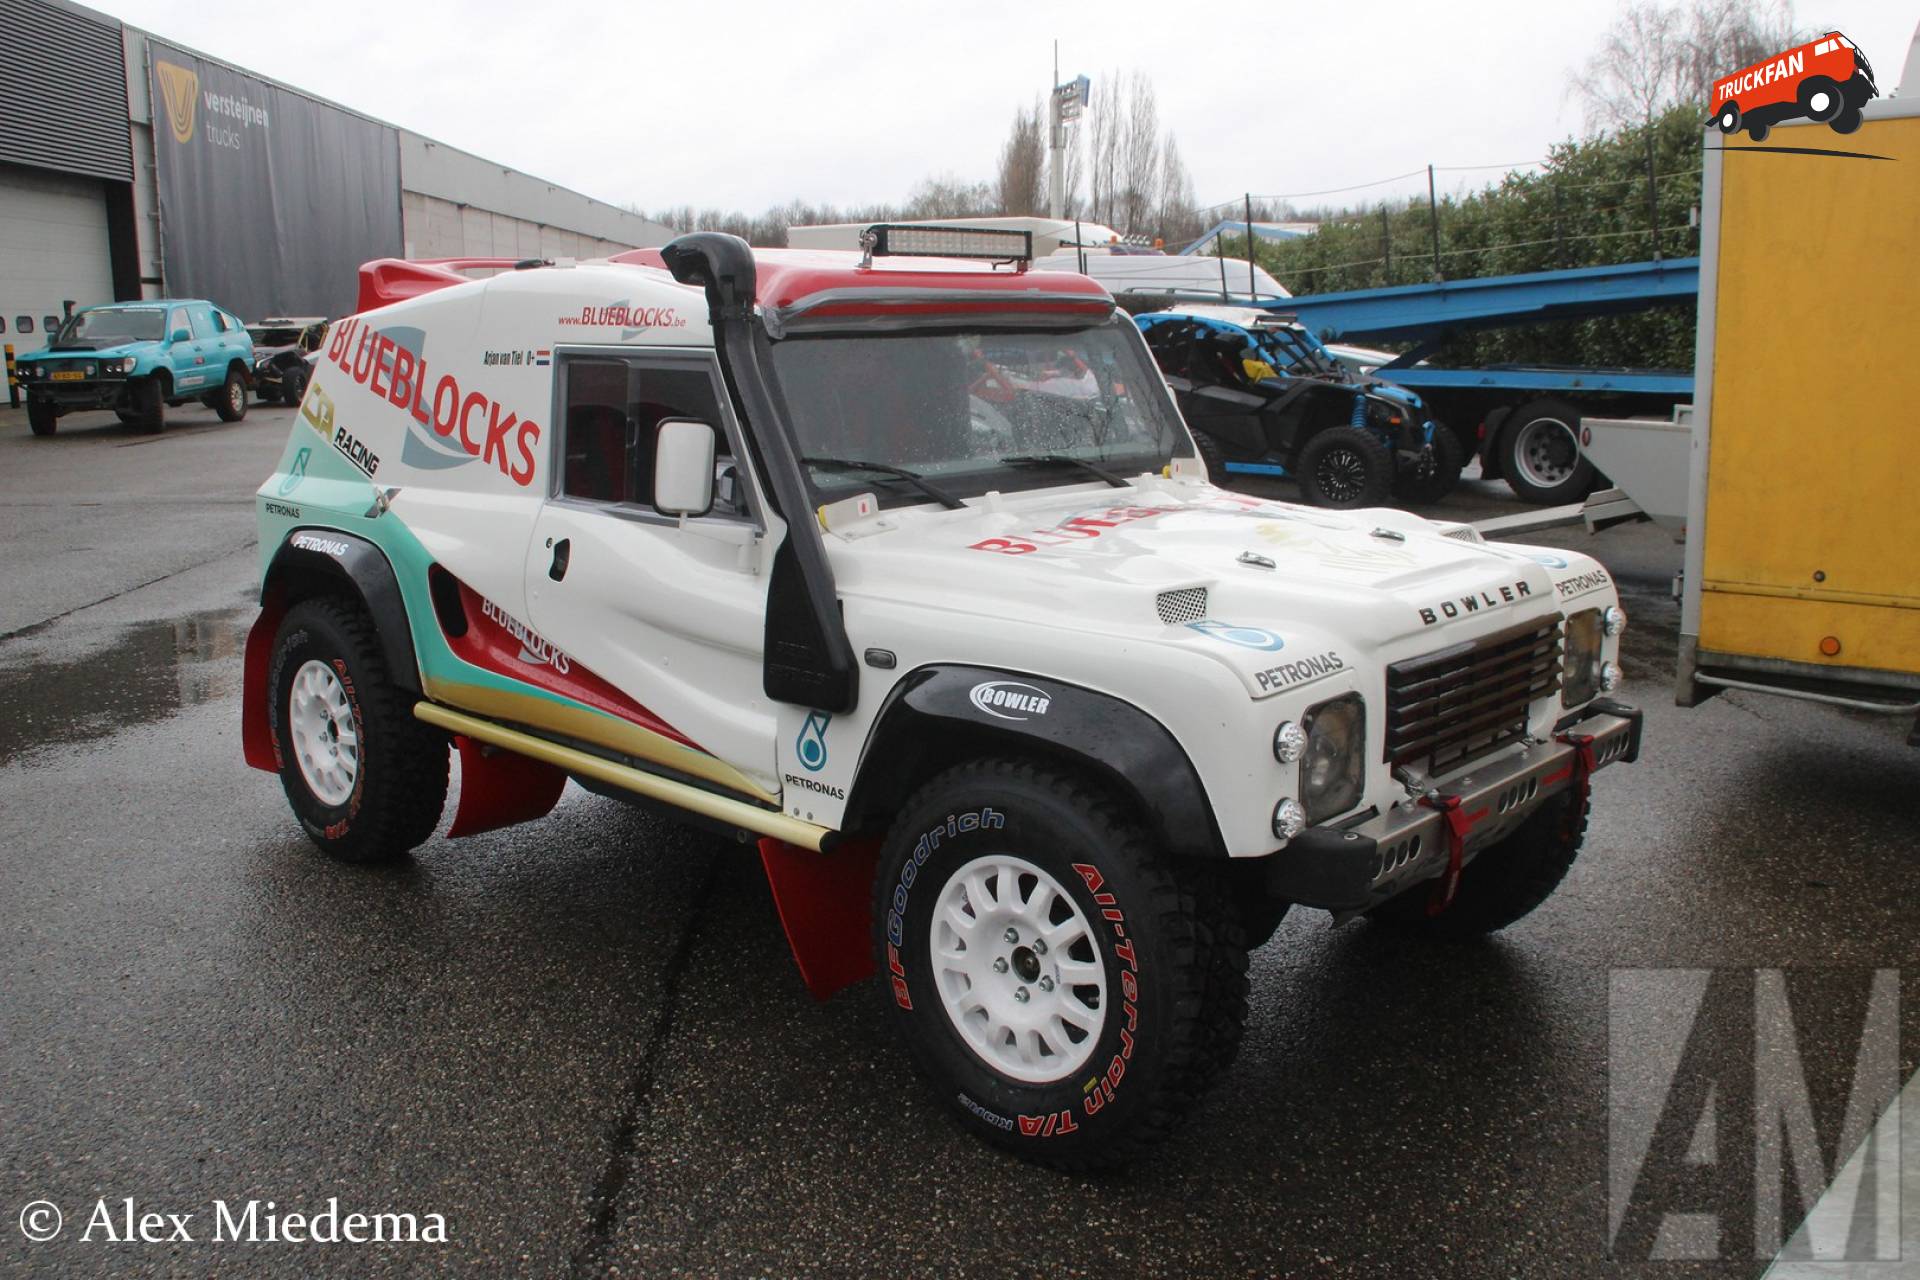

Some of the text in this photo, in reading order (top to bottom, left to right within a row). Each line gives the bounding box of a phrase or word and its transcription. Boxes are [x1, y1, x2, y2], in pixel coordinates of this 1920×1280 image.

[204, 91, 269, 128] versteijnen
[206, 121, 241, 150] trucks
[558, 306, 686, 328] www.BLUEBLOCKS.be
[500, 353, 510, 365] van
[328, 318, 541, 487] BLUEBLOCKS
[334, 426, 381, 475] RACING
[265, 503, 301, 519] PETRONAS
[293, 536, 350, 556] PETRONAS
[1555, 570, 1607, 597] PETRONAS
[1419, 581, 1531, 625] BOWLER
[482, 598, 570, 675] BLUEBLOCKS
[1255, 651, 1344, 691] PETRONAS
[981, 686, 1050, 714] BOWLER
[785, 773, 845, 801] PETRONAS
[887, 807, 1006, 1011] BFGoodrich
[1071, 862, 1139, 1116] All-Terrain
